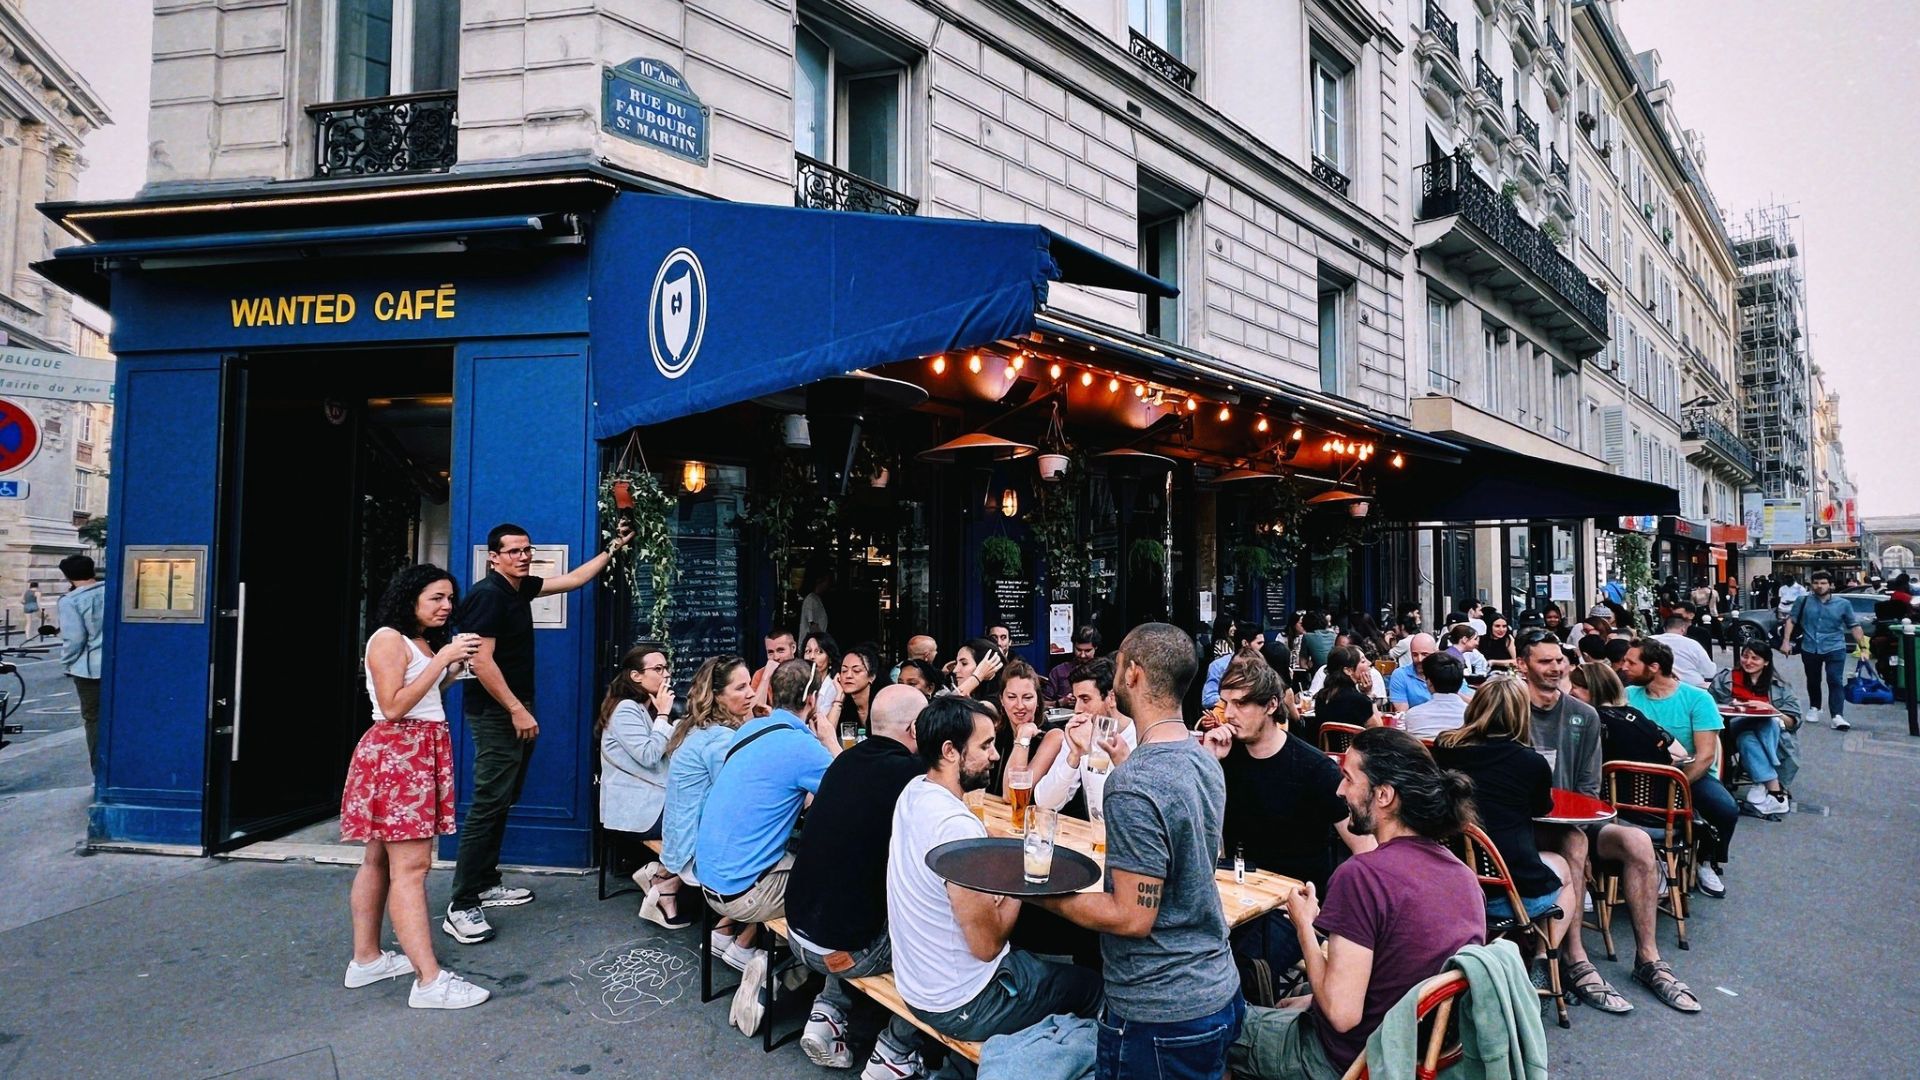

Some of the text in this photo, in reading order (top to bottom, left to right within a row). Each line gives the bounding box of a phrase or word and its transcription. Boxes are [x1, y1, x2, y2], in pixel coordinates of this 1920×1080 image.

[616, 99, 697, 139] FAUBOURG
[630, 88, 686, 120] RUE DU
[231, 283, 457, 328] WANTED CAFÉ
[48, 383, 65, 393] du
